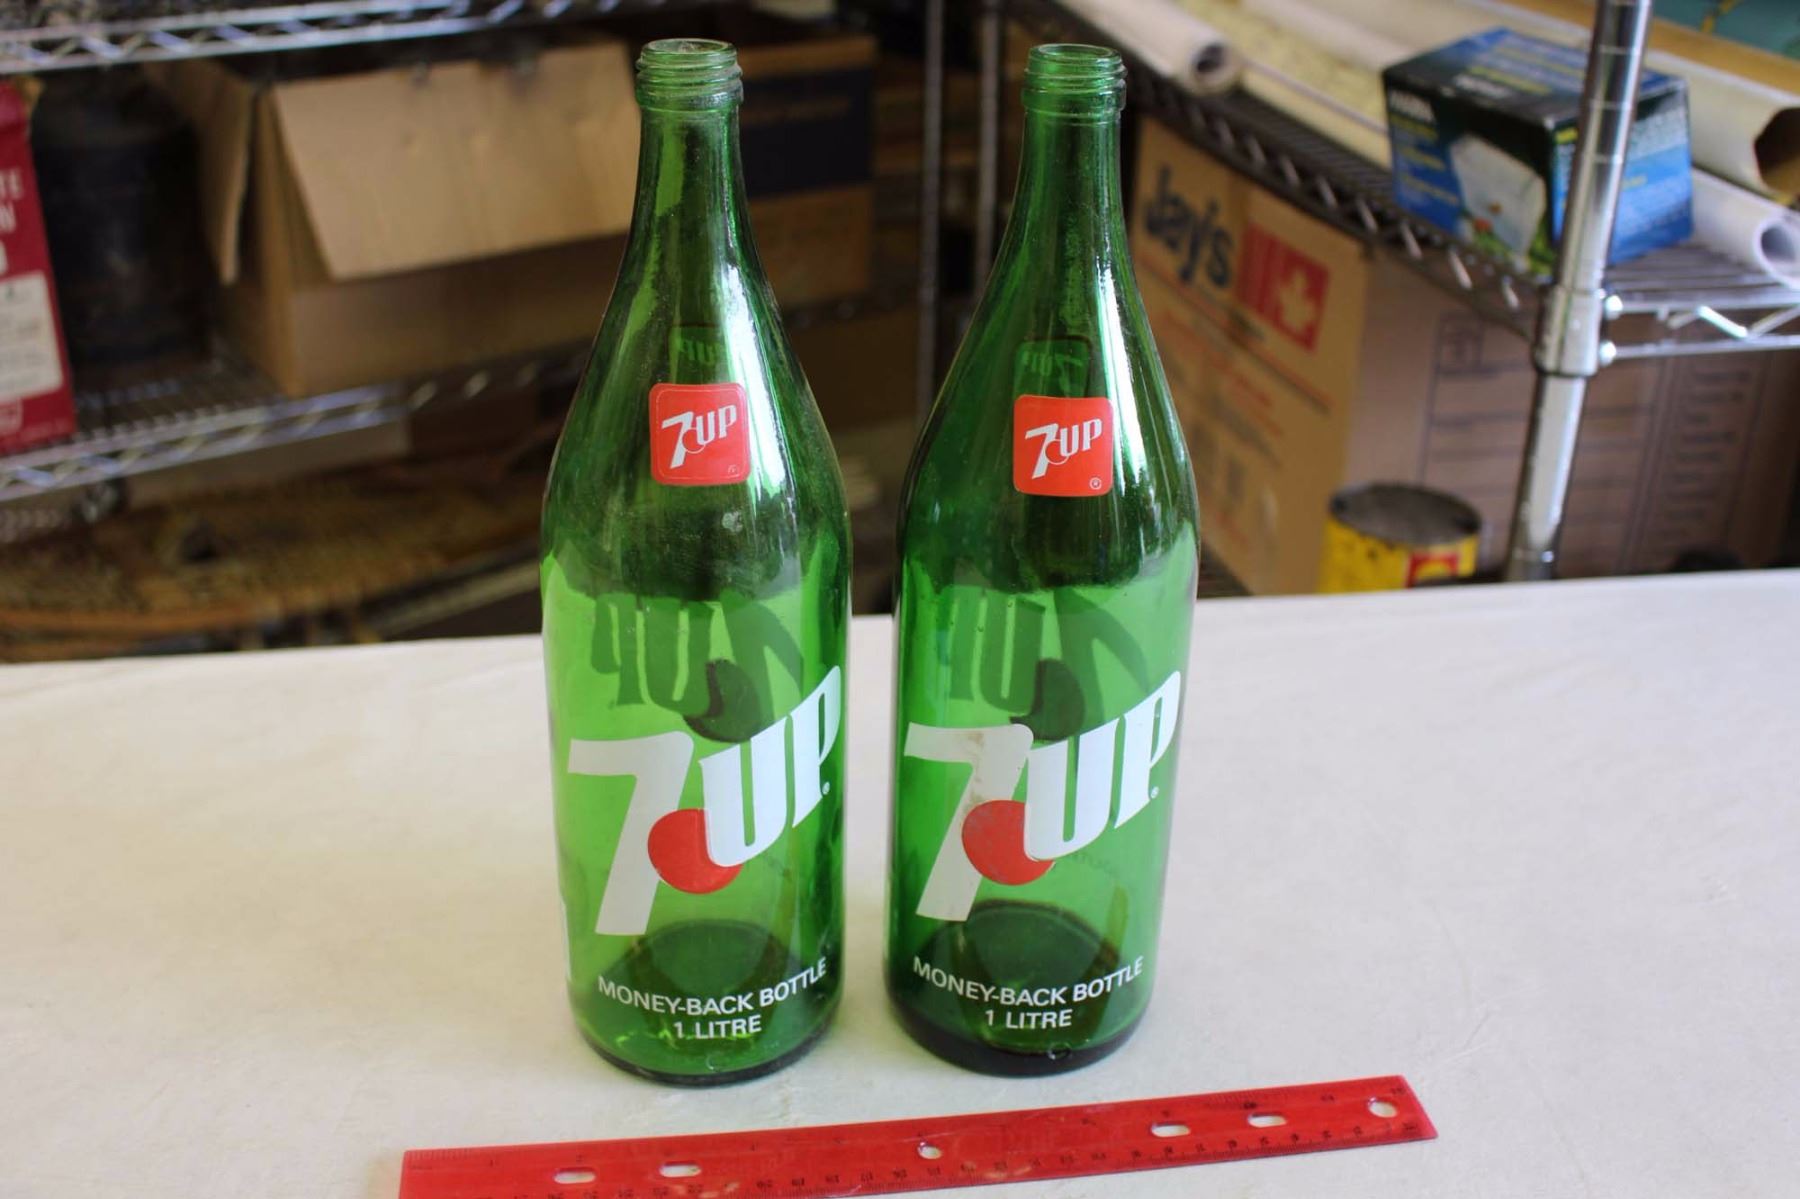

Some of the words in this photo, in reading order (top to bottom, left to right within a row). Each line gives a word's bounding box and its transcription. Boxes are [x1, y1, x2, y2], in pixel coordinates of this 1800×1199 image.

[661, 405, 737, 469] 7UP
[1025, 418, 1103, 479] 7UP
[567, 665, 841, 935] 7UP
[904, 670, 1181, 922] 7UP
[598, 975, 754, 1016] MONEY-BACK
[759, 957, 827, 1007] BOTTLE
[913, 956, 1068, 1006] MONEY-BACK
[1072, 956, 1144, 1002] BOTTLE
[674, 1022, 684, 1039] 1
[695, 1014, 762, 1040] LITRE
[985, 1010, 994, 1026] 1
[1005, 1009, 1073, 1029] LITRE
